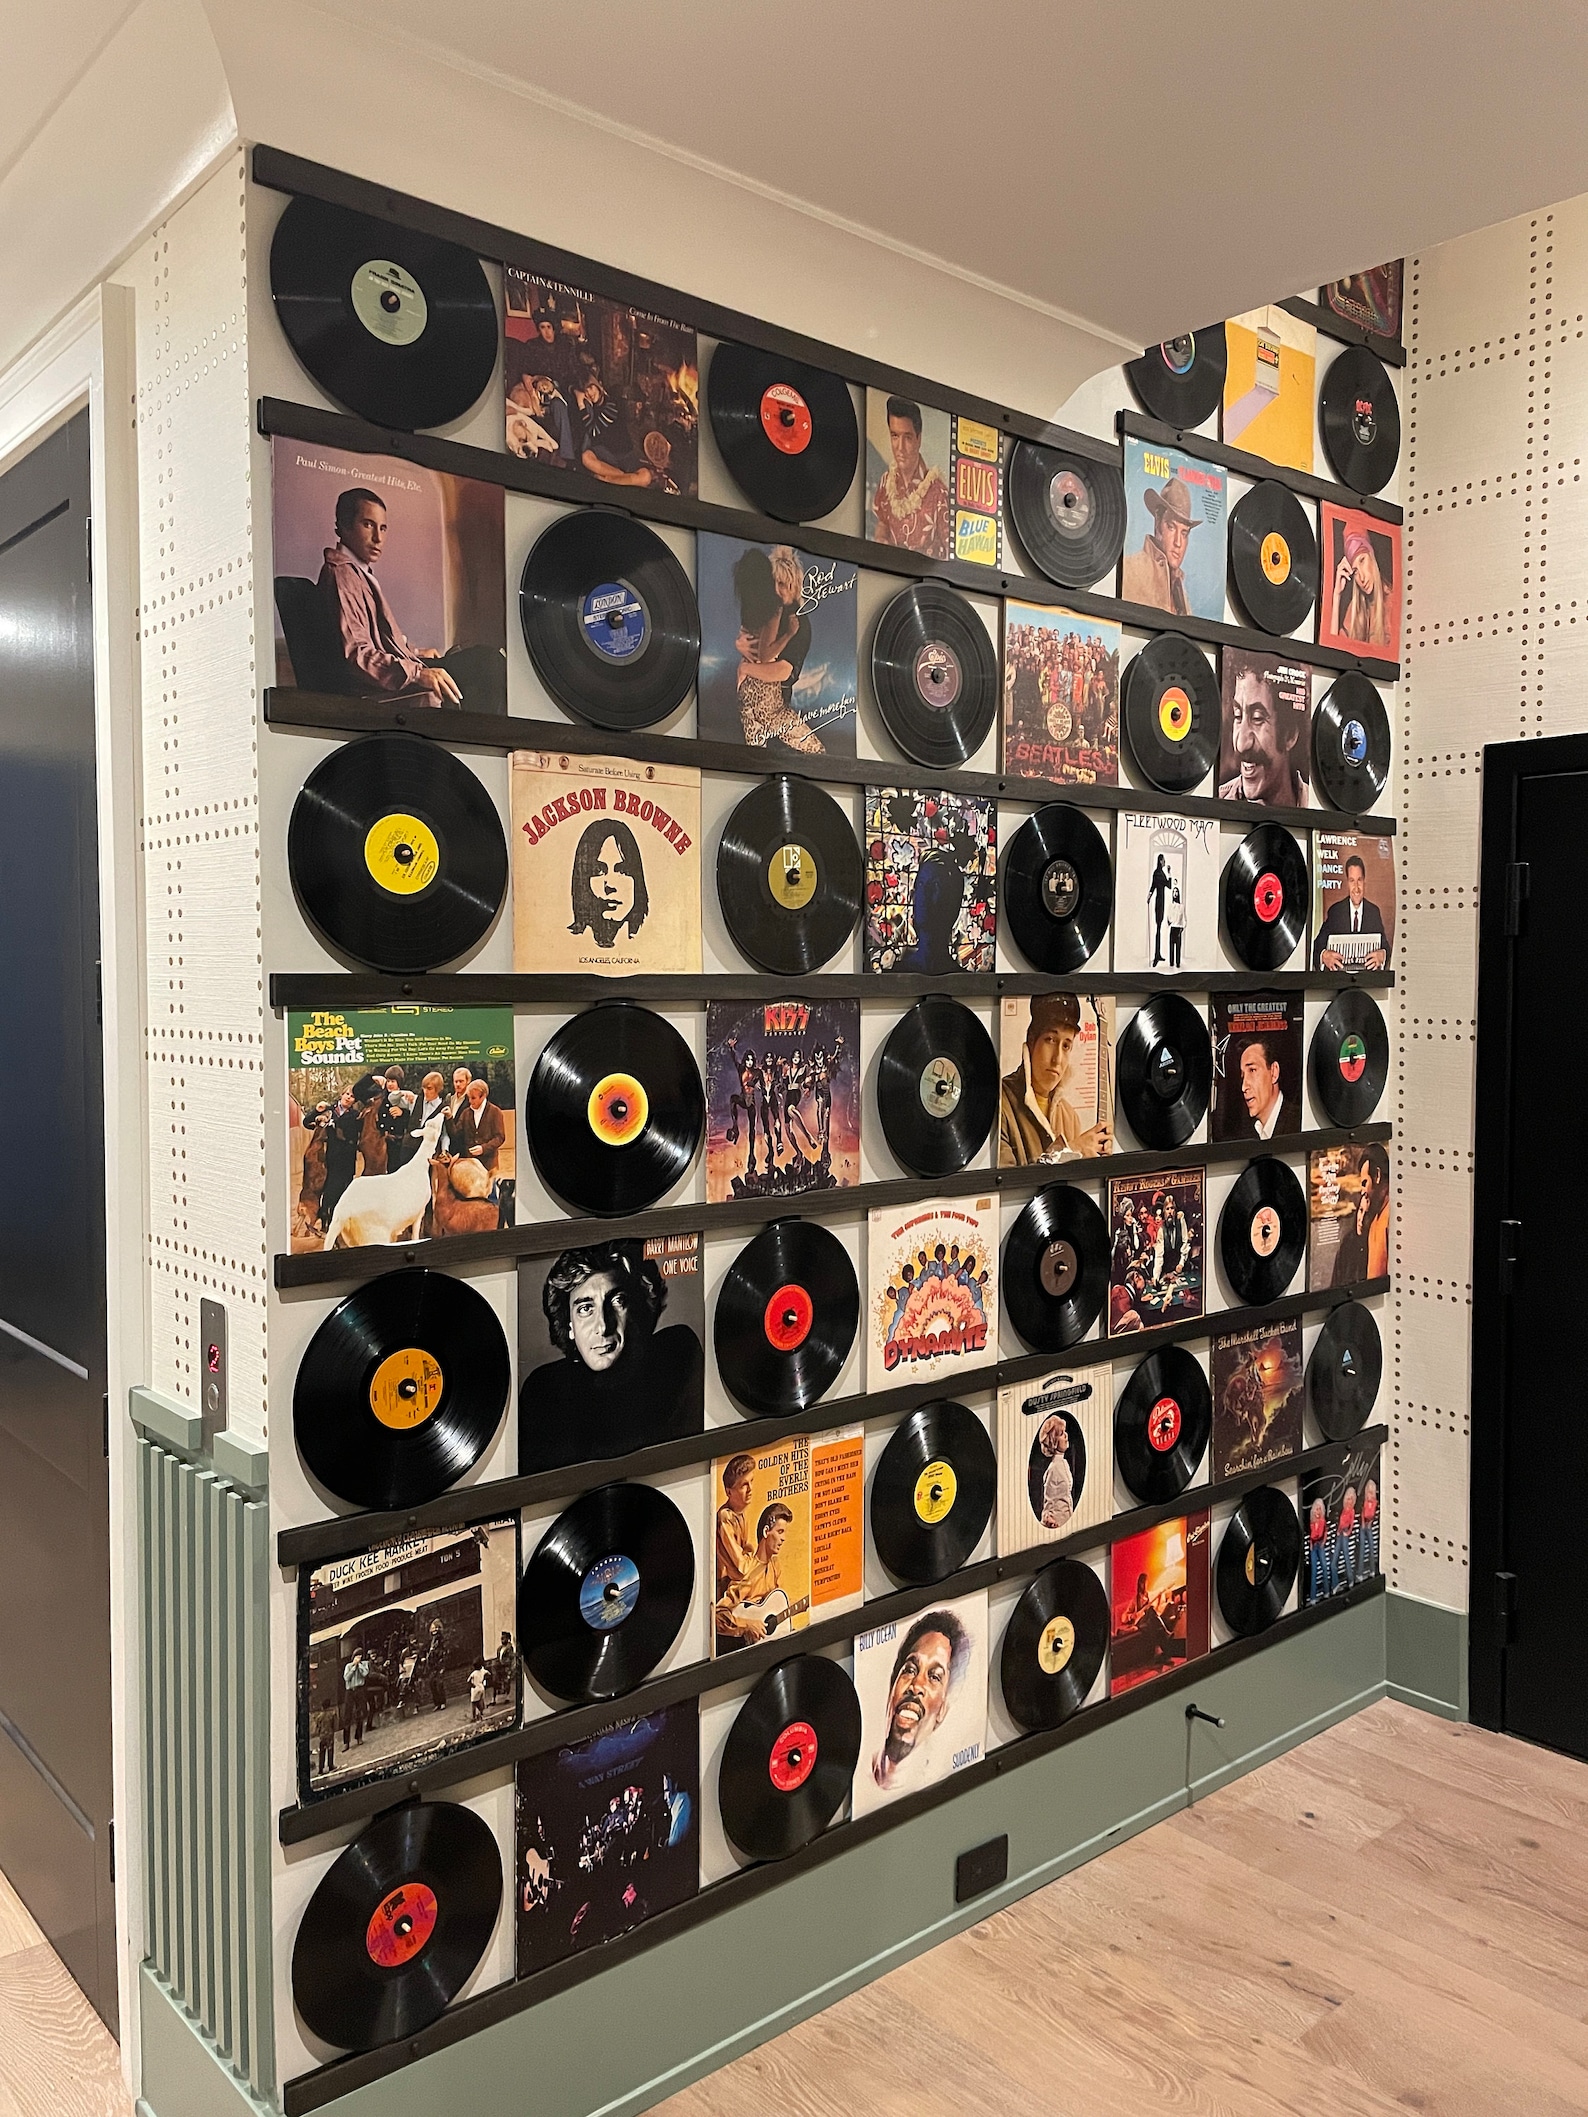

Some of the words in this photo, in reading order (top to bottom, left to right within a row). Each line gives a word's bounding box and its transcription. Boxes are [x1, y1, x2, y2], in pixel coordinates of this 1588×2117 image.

[508, 267, 546, 288] CAPTAIN
[552, 282, 595, 302] TENNILLE
[296, 455, 317, 469] Paul
[318, 461, 347, 475] Simon
[350, 467, 386, 485] Greatest
[1143, 452, 1170, 479] ELVIS
[959, 463, 994, 507] ELVIS
[958, 517, 989, 538] BLUE
[802, 562, 836, 594] Rod
[1015, 742, 1104, 773] BEATLES
[578, 764, 604, 776] Saturate
[604, 766, 623, 777] Before
[624, 769, 641, 780] Using
[522, 788, 607, 846] JACKSON
[613, 789, 692, 856] BROWNE
[1125, 813, 1187, 850] FLEETWOOD
[1189, 819, 1214, 855] MAC
[1316, 834, 1357, 846] LAWRENCE
[1316, 849, 1338, 860] WELK
[1317, 863, 1344, 874] DANCE
[1317, 879, 1342, 889] PARTY
[311, 1011, 345, 1026] The
[763, 1003, 810, 1031] KISS
[1227, 1003, 1243, 1014] ONLY
[1244, 1002, 1256, 1013] THE
[1257, 1002, 1287, 1013] GREATEST
[303, 1024, 354, 1038] Beach
[1080, 1032, 1096, 1043] Dylan
[1084, 1022, 1096, 1031] Bob
[294, 1037, 335, 1054] Boys
[335, 1036, 362, 1051] Pet
[301, 1049, 364, 1065] Sounds
[646, 1236, 665, 1255] BARRY
[667, 1232, 698, 1253] MANILOW
[663, 1259, 677, 1275] ONE
[680, 1256, 698, 1272] VOICE
[1218, 1336, 1230, 1350] The
[1231, 1328, 1259, 1346] Marshall
[1260, 1325, 1280, 1339] Tucker
[1280, 1319, 1297, 1334] Band
[208, 1344, 219, 1373] 2
[884, 1323, 988, 1372] DYNAMITE
[1028, 1394, 1049, 1407] DUSTY
[1049, 1384, 1087, 1401] SPRINGFIELD
[793, 1437, 809, 1449] THE
[758, 1452, 789, 1470] GOLDEN
[791, 1448, 809, 1461] HITS
[780, 1463, 790, 1475] OF
[793, 1459, 809, 1472] THE
[779, 1470, 809, 1487] EVERLY
[767, 1481, 809, 1501] BROTHERS
[822, 1489, 831, 1497] NOT
[329, 1561, 356, 1581] DUCK
[359, 1552, 379, 1570] KEE
[355, 1569, 374, 1580] FROZEN
[375, 1560, 390, 1571] FOOD
[391, 1552, 414, 1566] PRODUCE
[415, 1545, 428, 1557] MEAT
[859, 1631, 875, 1652] BILLY
[876, 1622, 897, 1645] OCEAN
[952, 1742, 981, 1769] SUDDENLY
[585, 1773, 604, 1786] WAY
[606, 1756, 644, 1778] STREET
